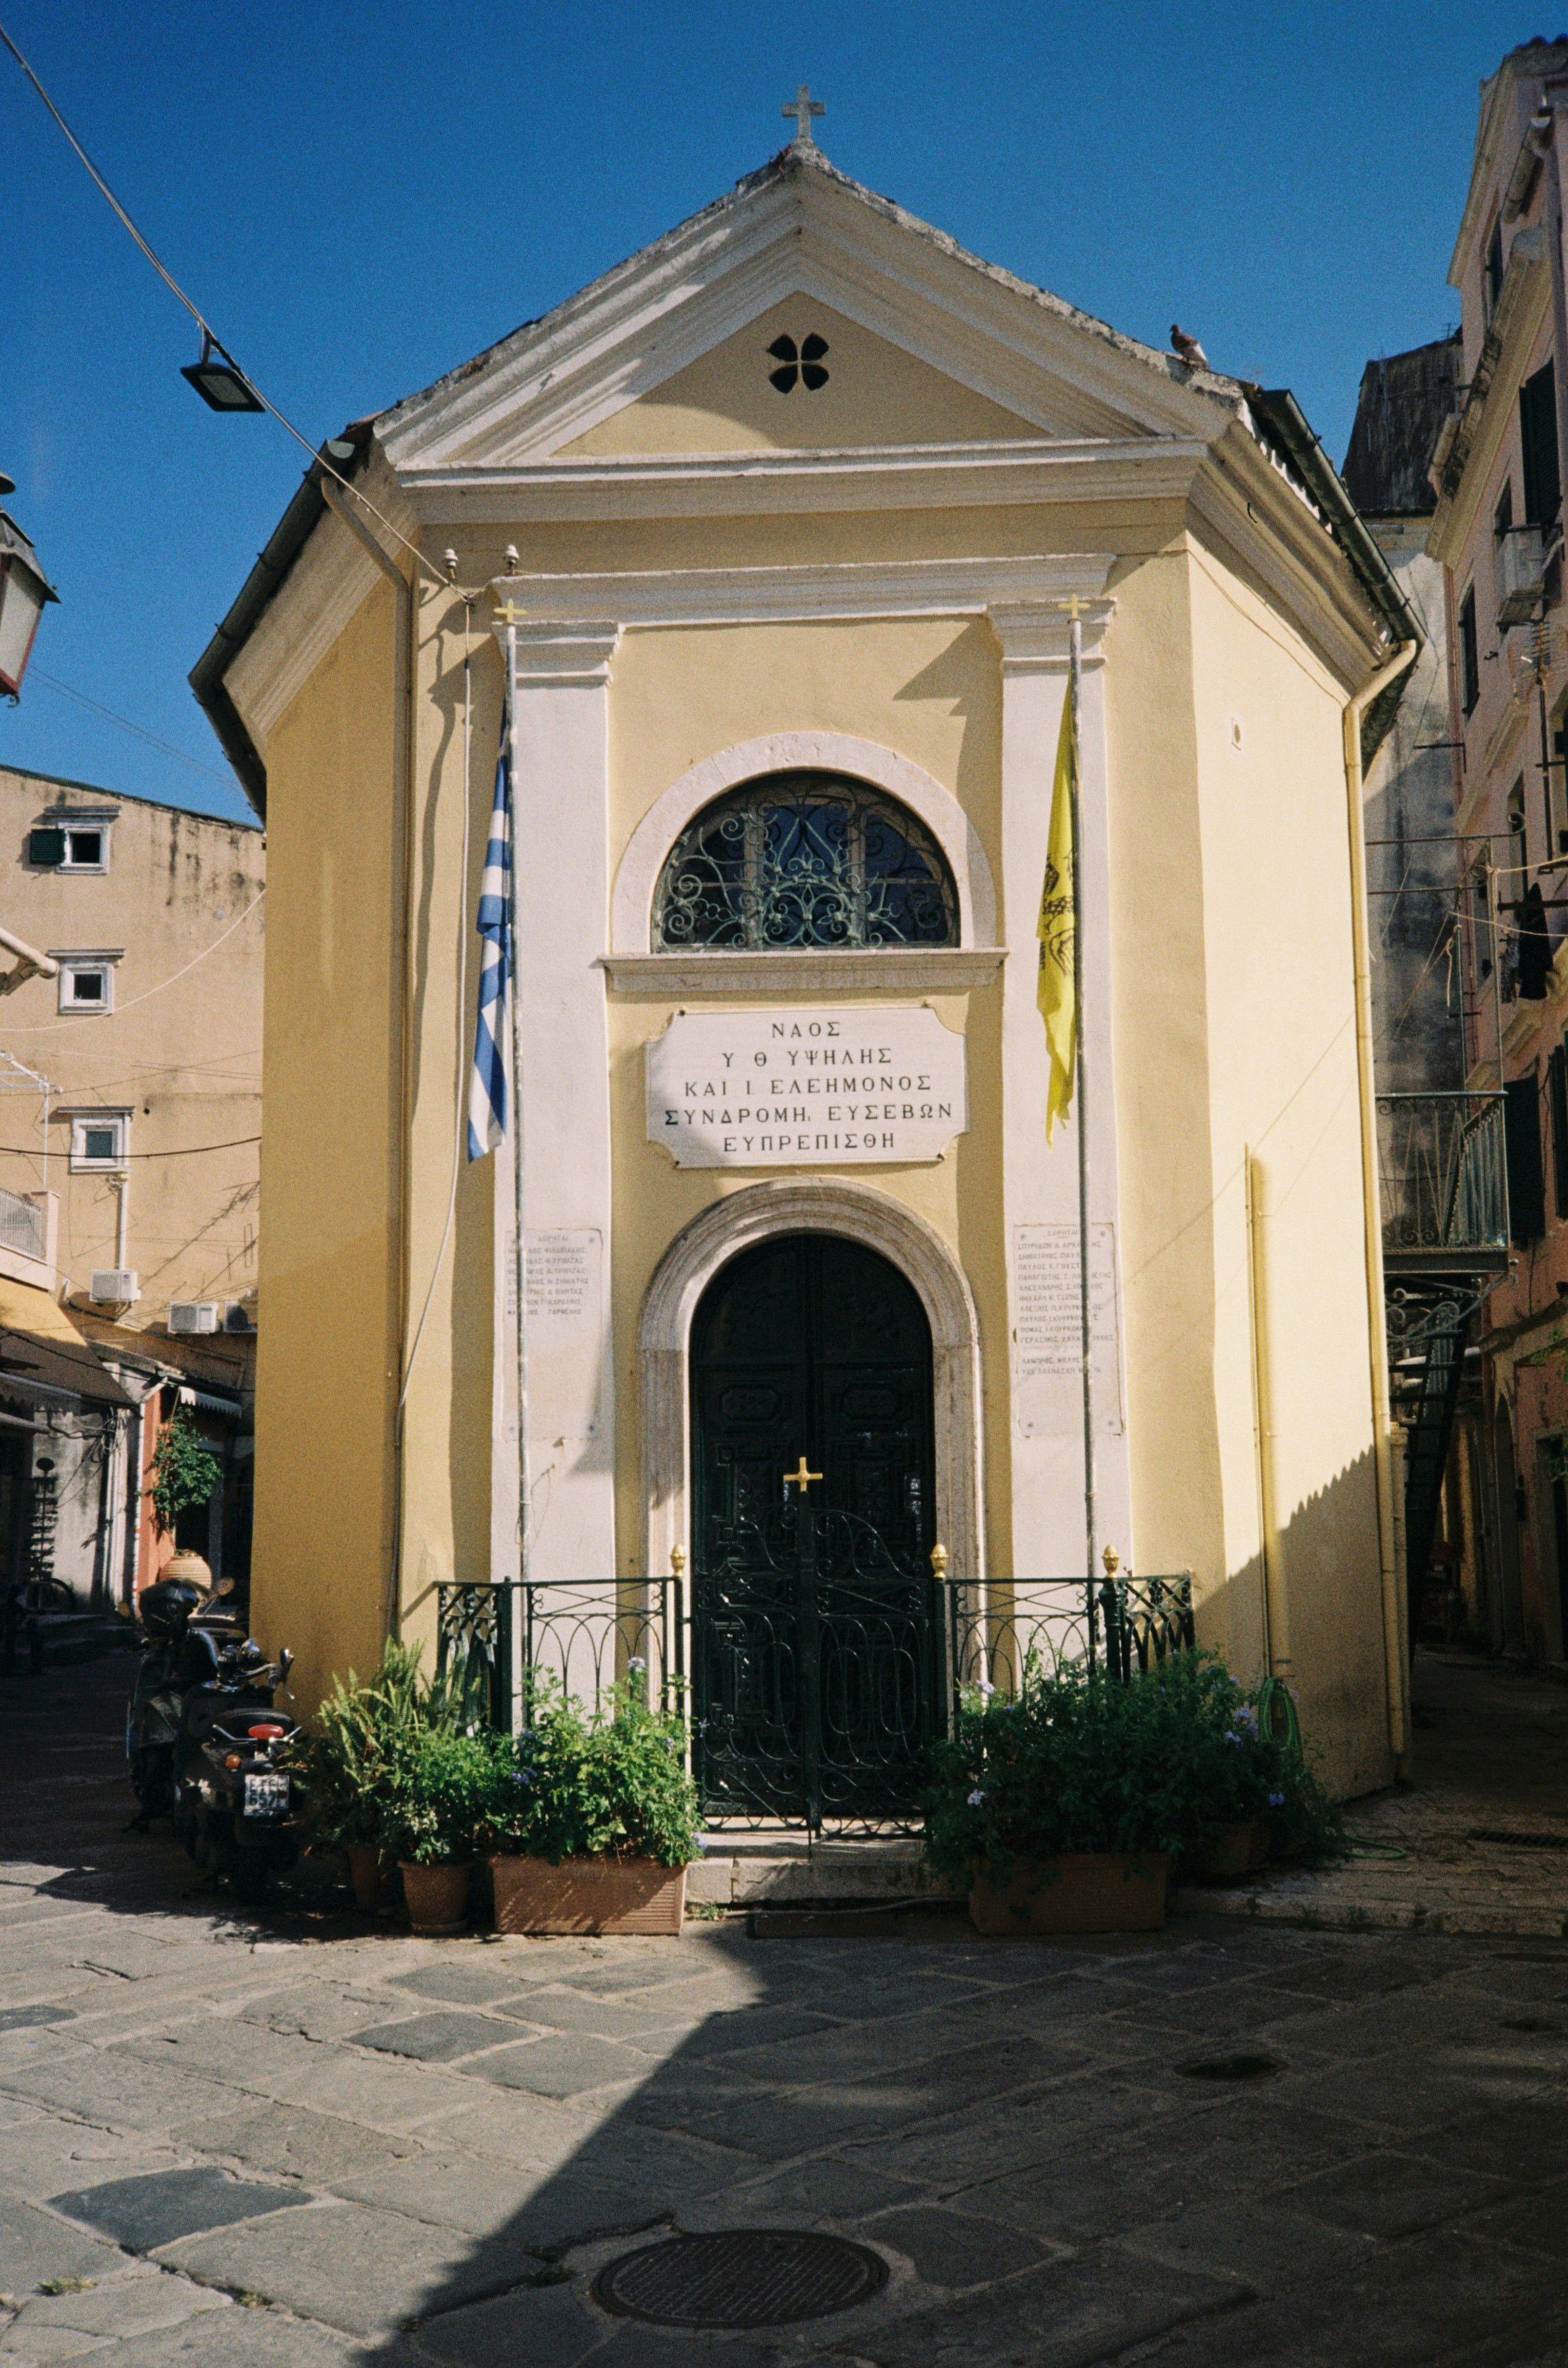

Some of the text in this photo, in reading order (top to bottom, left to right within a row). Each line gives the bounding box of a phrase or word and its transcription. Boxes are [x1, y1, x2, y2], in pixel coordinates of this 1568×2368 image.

[772, 1022, 841, 1038] ΝΑΟΣ
[722, 1048, 892, 1068] Υ Θ ΥΨΗΛΗΣ
[685, 1081, 727, 1097] ΚΑΙ
[770, 1075, 931, 1095] ΕΛΕΗΜΟΝΟΣ
[828, 1103, 952, 1121] ΕΥΣΕΒΩΝ
[724, 1133, 895, 1152] ΕΥΠΡΕΠΙΣΘΗ
